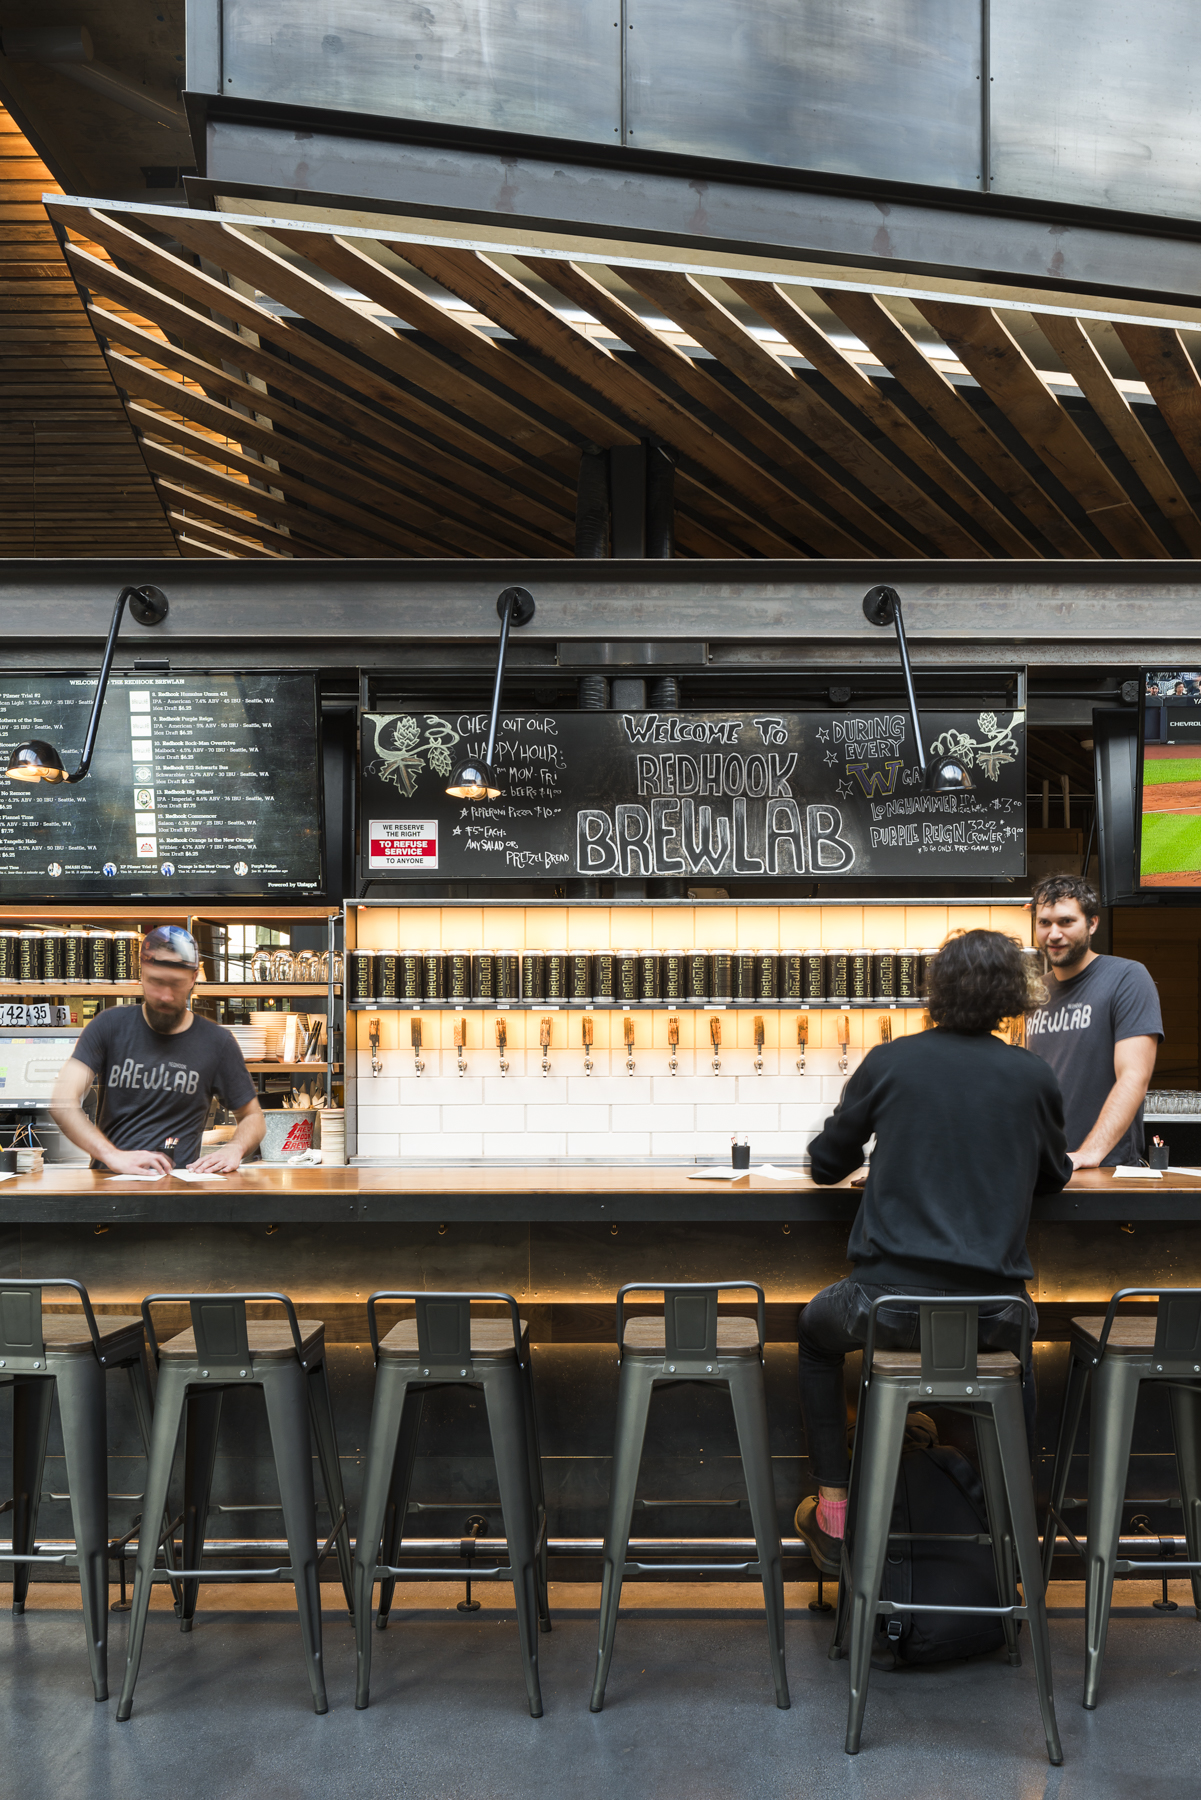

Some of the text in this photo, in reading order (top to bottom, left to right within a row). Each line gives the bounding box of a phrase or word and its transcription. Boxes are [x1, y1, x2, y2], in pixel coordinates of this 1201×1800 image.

[457, 714, 504, 736] CHEC
[526, 718, 558, 735] OUR
[833, 715, 905, 744] DURING
[467, 741, 518, 762] HAPY
[845, 739, 905, 760] EVERY
[509, 767, 533, 783] MON
[636, 752, 798, 797] REDHOOK
[846, 760, 904, 798] W
[870, 794, 957, 821] LONGHAMMER
[960, 794, 976, 806] IPA
[482, 839, 504, 851] SALAD
[577, 797, 855, 876] BREWLAB
[870, 823, 919, 847] PURPLE
[923, 821, 965, 844] REIGN
[966, 830, 1005, 844] CROWLER
[544, 851, 570, 869] BREAD
[20, 940, 31, 978] BREWLAB
[44, 938, 54, 977] BREWLAB
[66, 938, 76, 977] BREWLAB
[93, 939, 105, 978] BREWLAB
[116, 940, 126, 978] BREWLAB
[357, 957, 368, 996] BREWLAB
[383, 957, 396, 996] BREWLAB
[404, 957, 416, 996] BREWLAB
[452, 957, 464, 996] BREWLAB
[480, 957, 491, 996] BREWLAB
[524, 957, 533, 997] BREWLAB
[549, 957, 560, 996] BREWLAB
[574, 957, 586, 996] BREWLAB
[601, 956, 612, 995] BREWLAB
[643, 958, 654, 996] BREWLAB
[667, 958, 678, 996] BREWLAB
[693, 956, 704, 995] BREWLAB
[761, 958, 772, 996] BREWLAB
[790, 957, 800, 996] BREWLAB
[809, 957, 820, 996] BREWLAB
[835, 956, 847, 995] BREWLAB
[853, 957, 864, 996] BREWLAB
[881, 956, 892, 995] BREWLAB
[900, 957, 912, 996] BREWLAB
[426, 958, 437, 997] BREWLAB
[622, 959, 633, 998] BREWLAB
[6, 1006, 24, 1019] 42
[33, 1006, 47, 1019] 35
[1026, 1004, 1092, 1037] BREWLAB
[108, 1058, 200, 1095] BREWLAB
